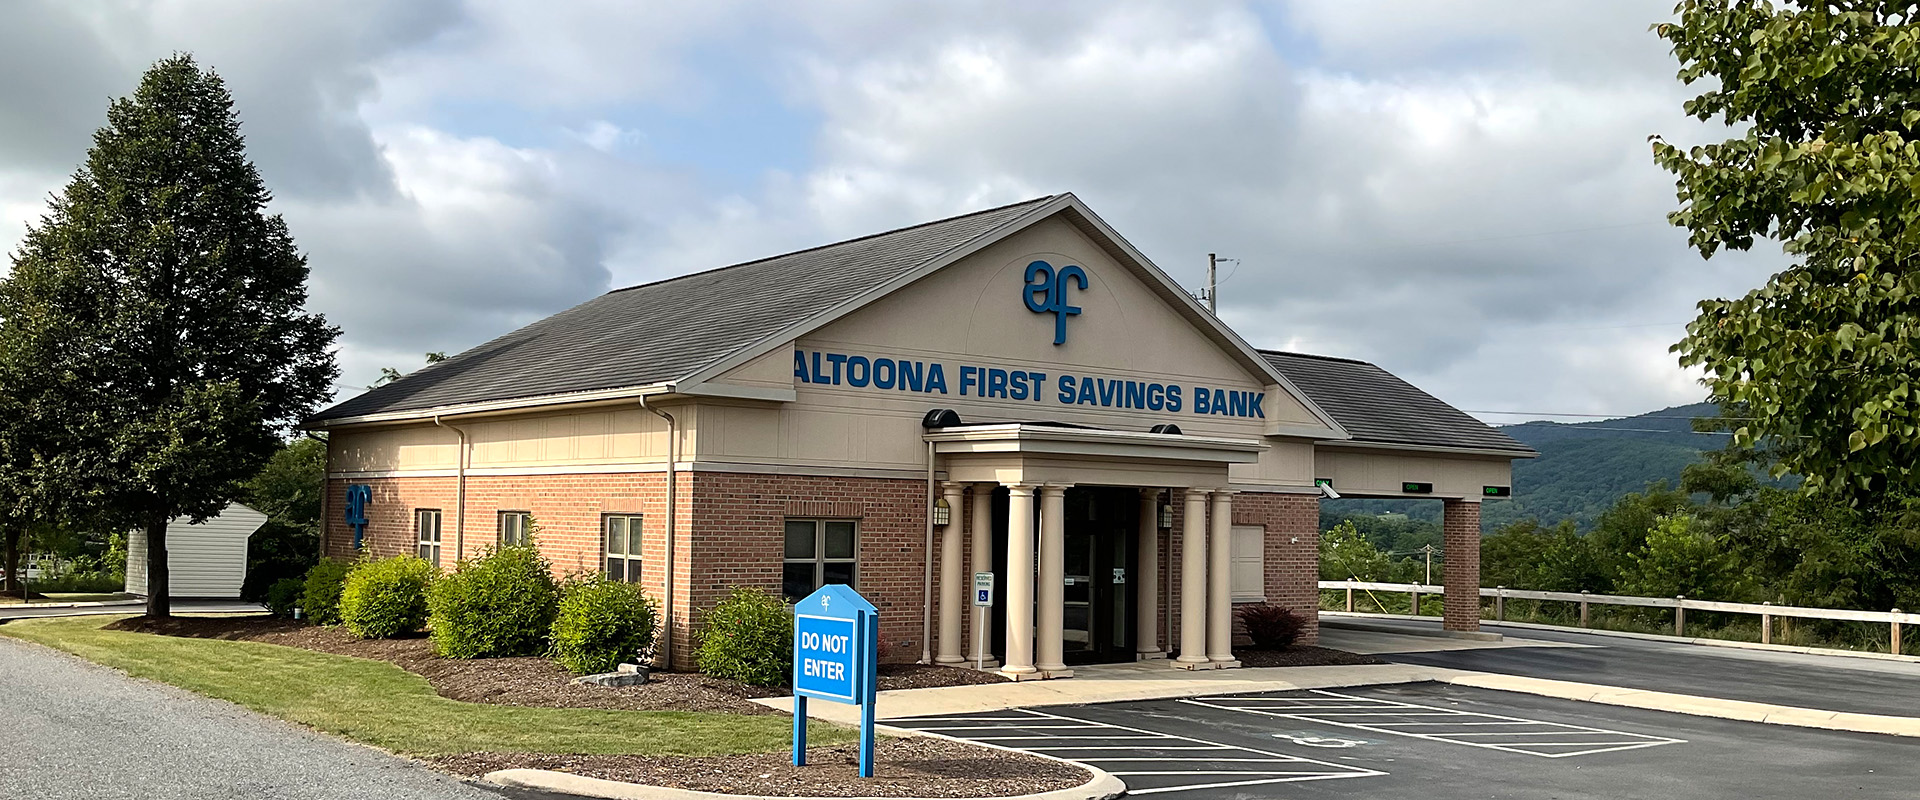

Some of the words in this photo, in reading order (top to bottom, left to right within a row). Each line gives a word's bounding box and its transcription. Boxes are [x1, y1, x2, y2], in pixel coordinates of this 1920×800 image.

[794, 350, 948, 395] ALTOONA
[960, 365, 1047, 402] FIRST
[1058, 375, 1182, 412] SAVINGS
[1194, 387, 1265, 418] BANK
[801, 631, 820, 651] DO
[822, 633, 849, 654] NOT
[804, 657, 845, 681] ENTER
